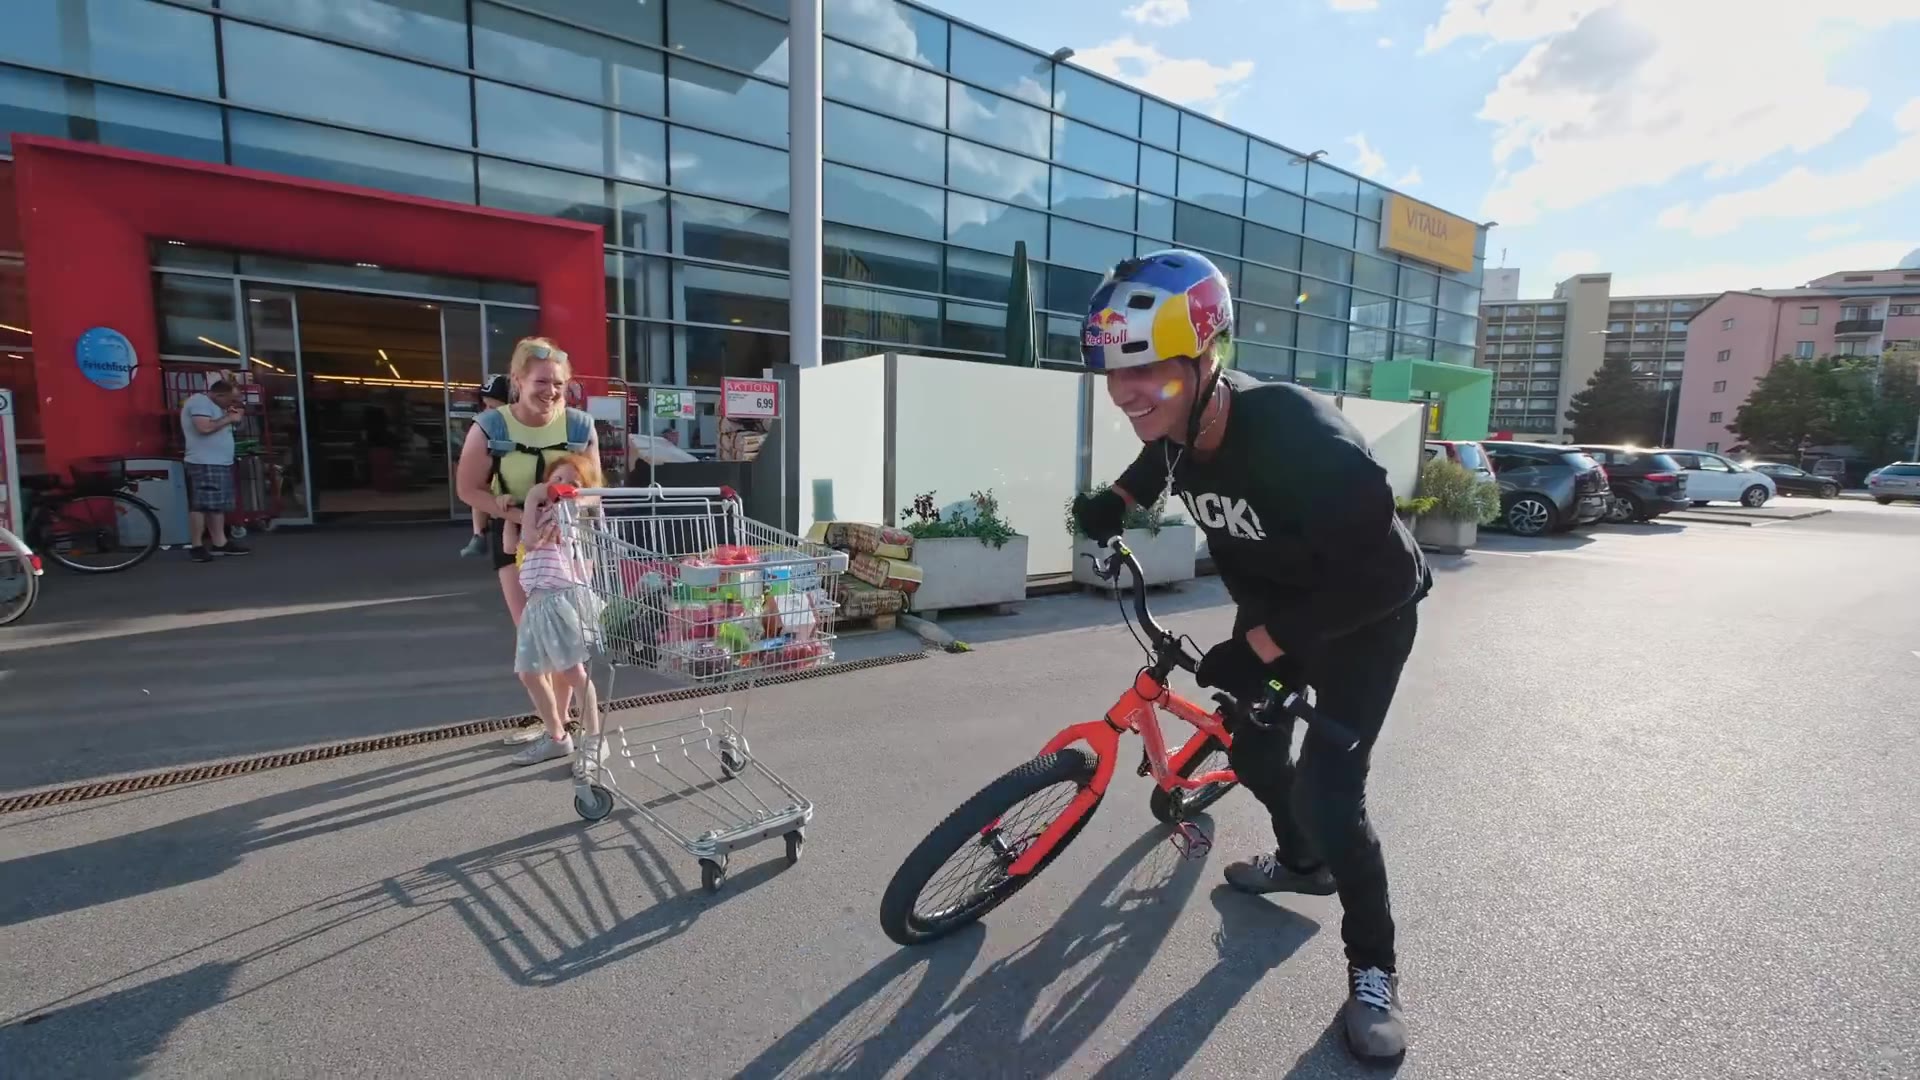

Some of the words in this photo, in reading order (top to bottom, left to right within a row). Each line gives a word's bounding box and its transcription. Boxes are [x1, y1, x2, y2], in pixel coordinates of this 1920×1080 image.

[1406, 207, 1448, 241] VITALIA
[1085, 331, 1104, 345] Red
[1105, 329, 1128, 345] Bull
[656, 394, 679, 406] 2+1
